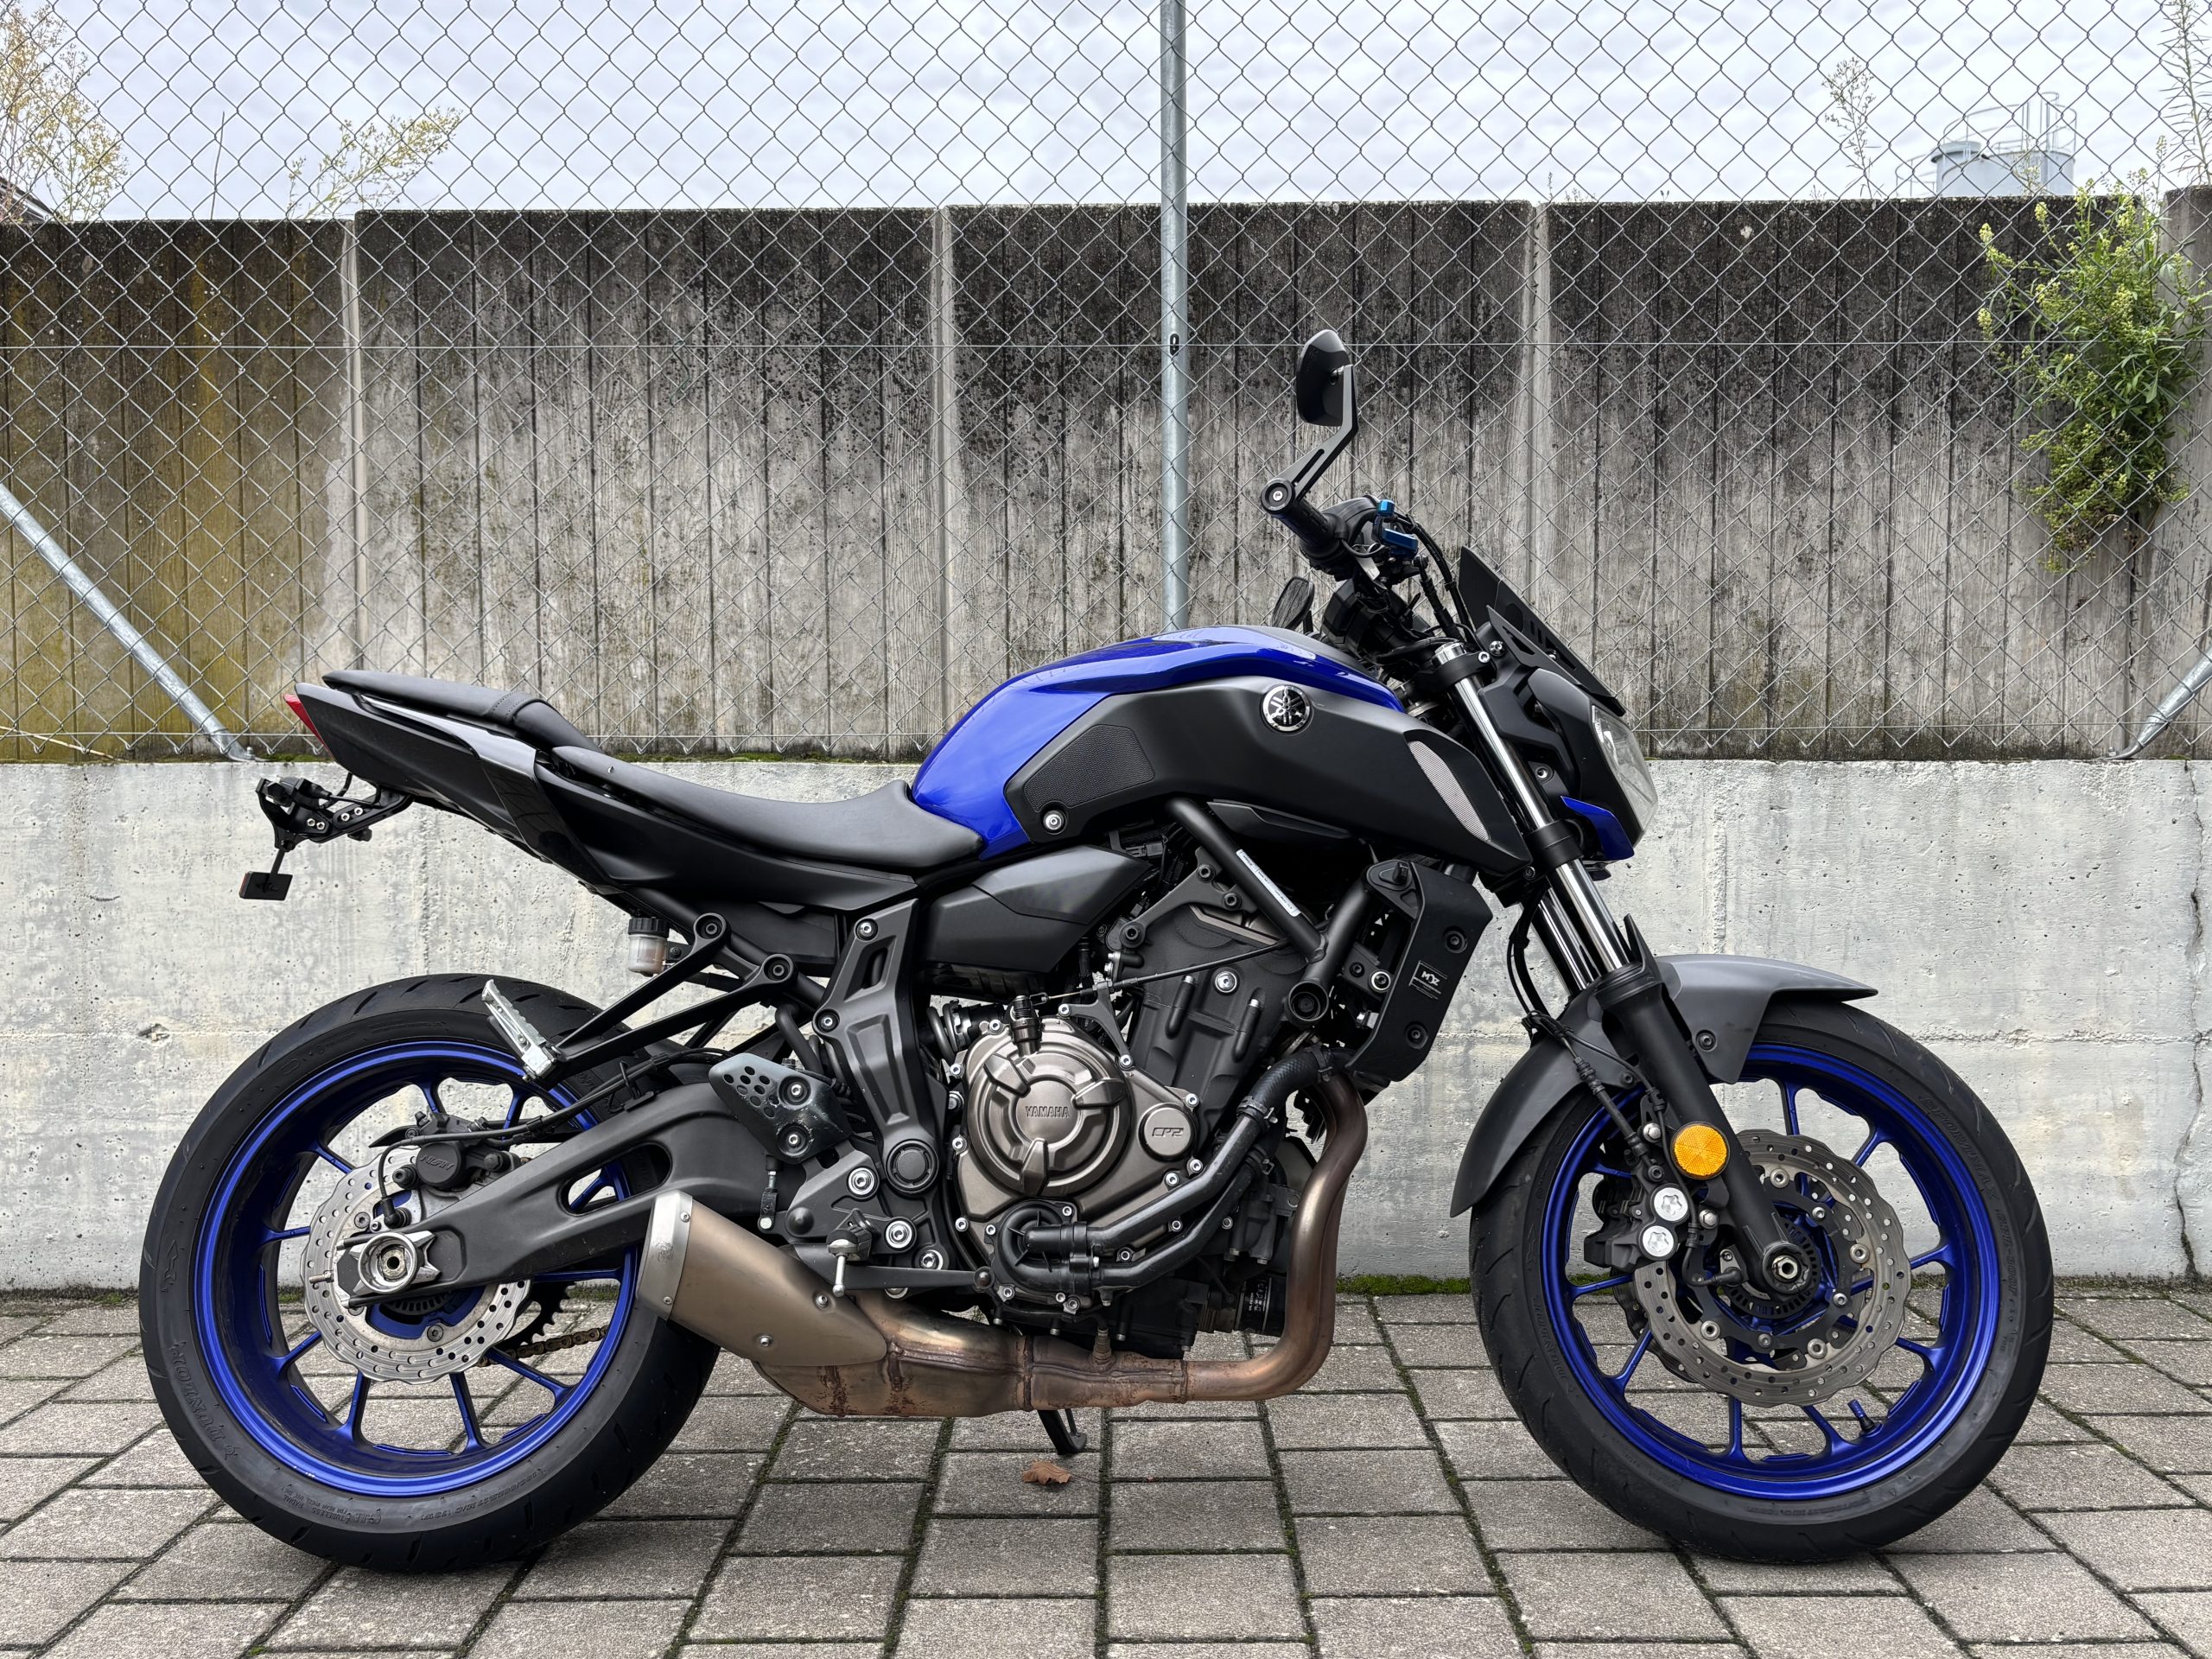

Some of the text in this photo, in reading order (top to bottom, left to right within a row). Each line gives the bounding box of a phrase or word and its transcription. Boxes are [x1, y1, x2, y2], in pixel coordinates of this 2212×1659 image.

[1026, 1106, 1070, 1118] YAMAHA
[1152, 1127, 1184, 1137] CP2
[172, 1344, 226, 1442] DUNLOP
